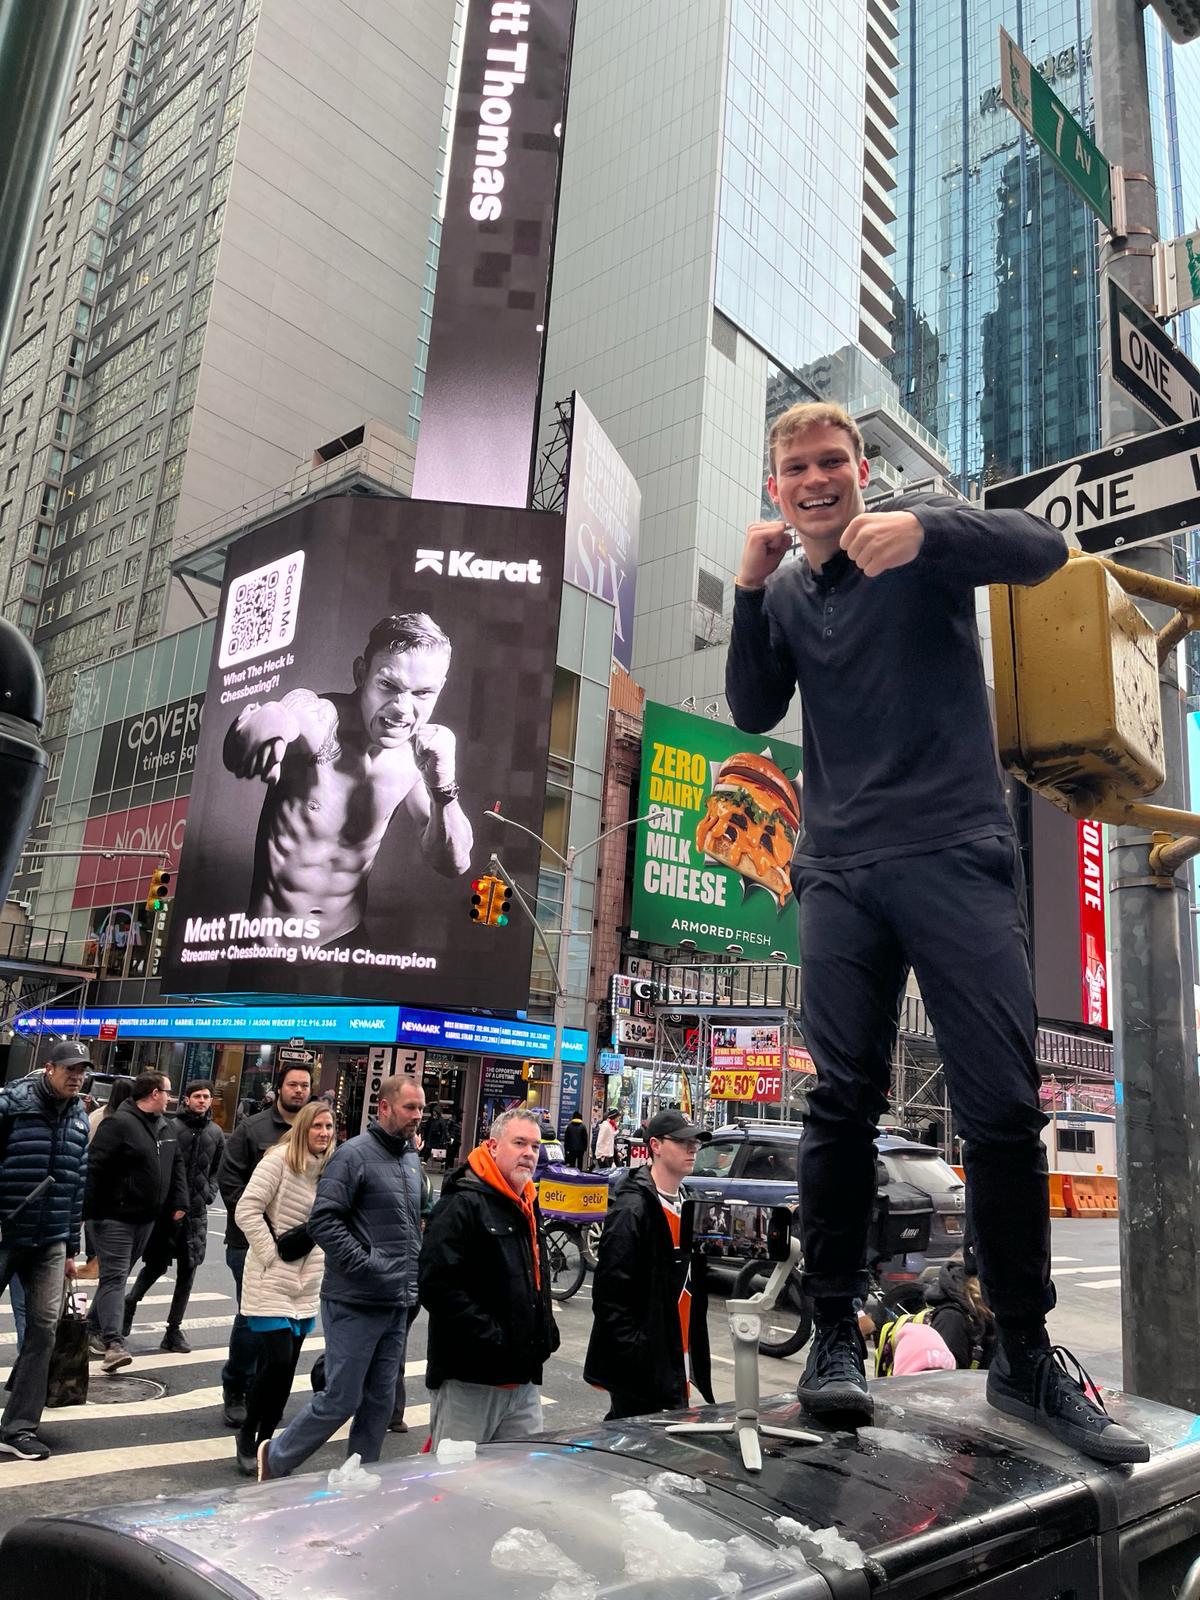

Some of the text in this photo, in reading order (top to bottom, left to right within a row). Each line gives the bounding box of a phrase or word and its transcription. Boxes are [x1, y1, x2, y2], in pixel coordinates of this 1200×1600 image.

[469, 41, 528, 222] Thomas
[1051, 101, 1091, 175] 7 AV
[1129, 330, 1171, 402] ONE
[1045, 473, 1135, 531] ONE
[448, 550, 541, 584] Karat
[279, 563, 297, 638] Scan Me
[223, 653, 295, 687] What The Heck Is
[220, 673, 280, 705] Chessboxing?!
[143, 750, 176, 771] times
[651, 742, 706, 786] ZERO
[650, 776, 704, 812] DAIRY
[647, 803, 684, 835] OAT
[113, 822, 167, 860] NOW
[646, 831, 691, 865] MILK
[643, 860, 727, 907] CHEESE
[184, 912, 321, 943] Matt Thomas
[671, 918, 771, 946] ARMORED FRESH
[181, 948, 219, 963] Streamer
[227, 944, 298, 962] Chessboxing
[301, 945, 349, 963] World
[352, 948, 437, 969] Champion
[252, 1019, 271, 1027] JASON
[272, 1019, 295, 1027] WECKER
[296, 1019, 337, 1027] 212.916.3365
[350, 1018, 385, 1029] NEWMARK
[402, 1021, 440, 1035] NEWMARK
[495, 1067, 522, 1075] OPPORTUNIT
[746, 1055, 781, 1067] SALE
[788, 1056, 811, 1071] SALE
[711, 1074, 781, 1096] 20% 50% OFF
[544, 1190, 567, 1202] getir
[582, 1191, 603, 1207] getir
